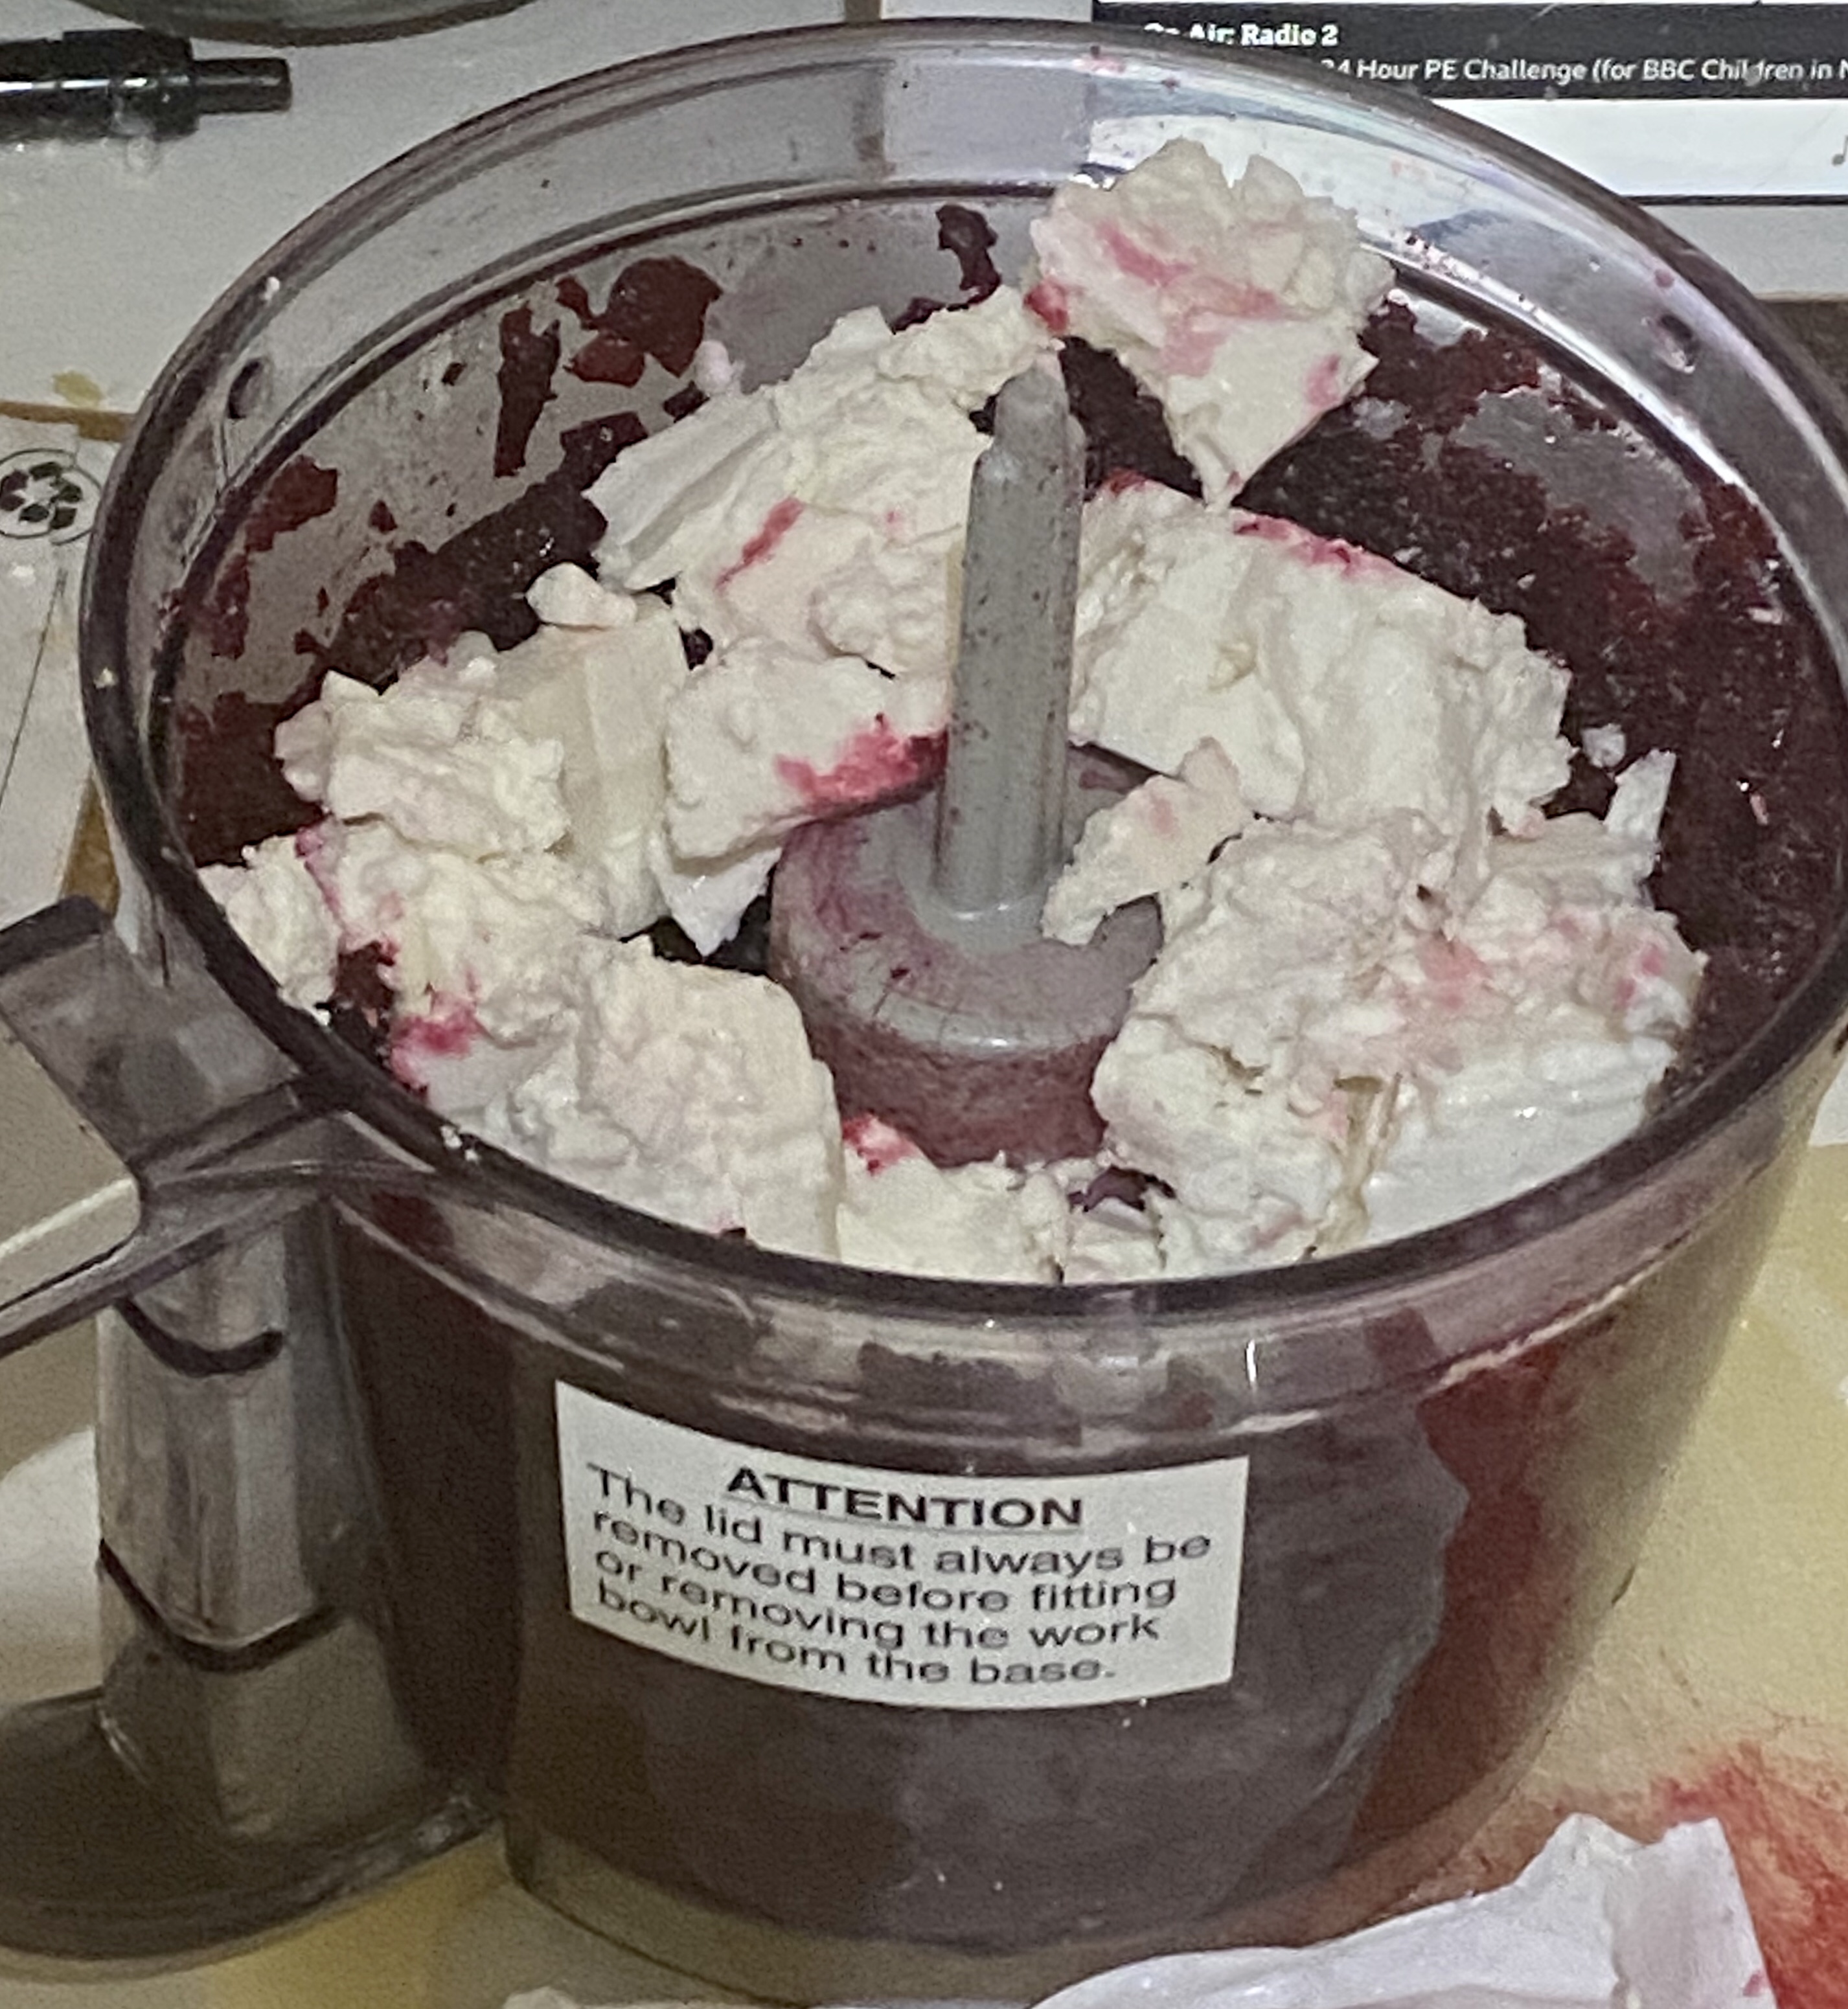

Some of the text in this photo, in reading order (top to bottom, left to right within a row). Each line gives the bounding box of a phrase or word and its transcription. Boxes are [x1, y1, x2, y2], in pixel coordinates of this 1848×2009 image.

[1240, 23, 1316, 46] Radio
[1321, 24, 1339, 46] 2
[1356, 59, 1419, 79] Hour
[1424, 59, 1459, 80] PE
[1463, 59, 1588, 85] Challenge
[1592, 59, 1639, 82] (for
[1642, 59, 1696, 80] BBC
[1810, 59, 1833, 80] in
[587, 1462, 1211, 1578] The lid must always be
[727, 1466, 1082, 1528] ATTENTION
[593, 1511, 1176, 1613] removed before fitting
[596, 1550, 1158, 1651] or removing the work
[598, 1578, 1118, 1684] bowl from the base.
